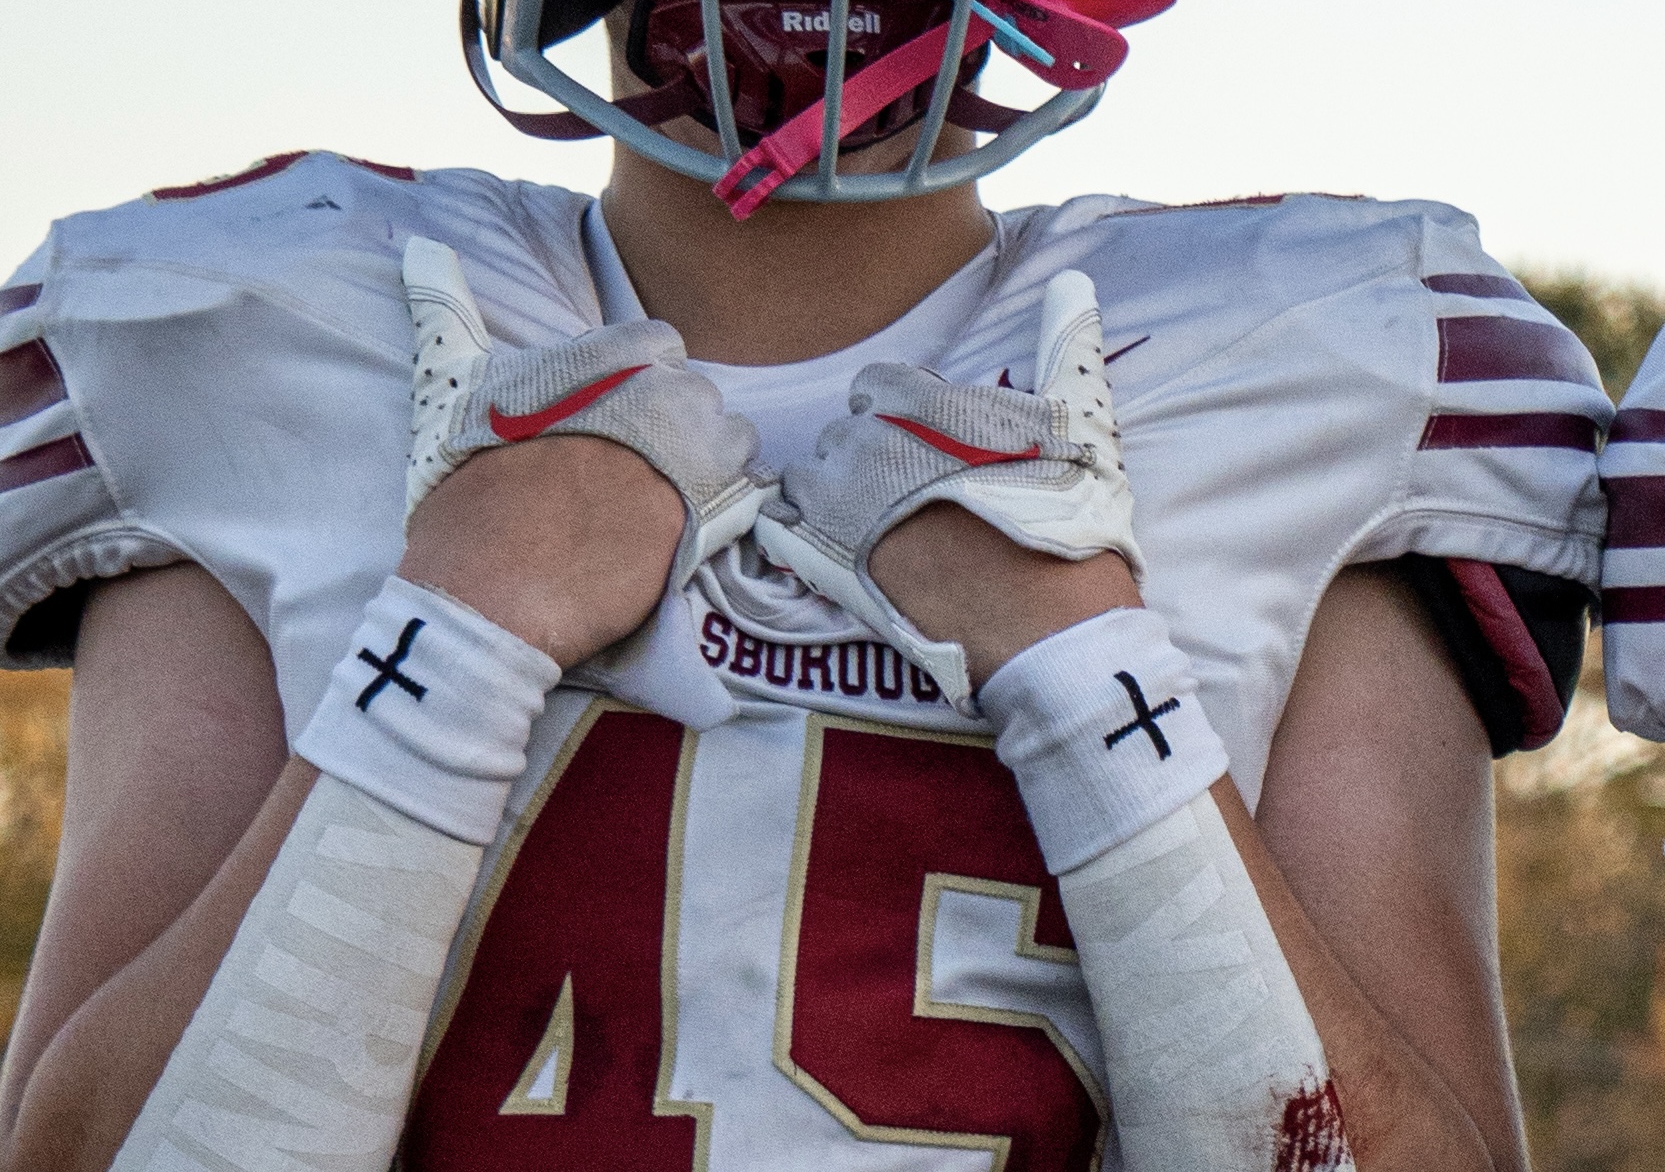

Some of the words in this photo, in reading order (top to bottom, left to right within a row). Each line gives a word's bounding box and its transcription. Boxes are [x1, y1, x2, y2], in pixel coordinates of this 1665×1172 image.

[782, 11, 881, 34] Ridell
[700, 611, 952, 704] SBOROUG
[393, 698, 1107, 1172] 45
